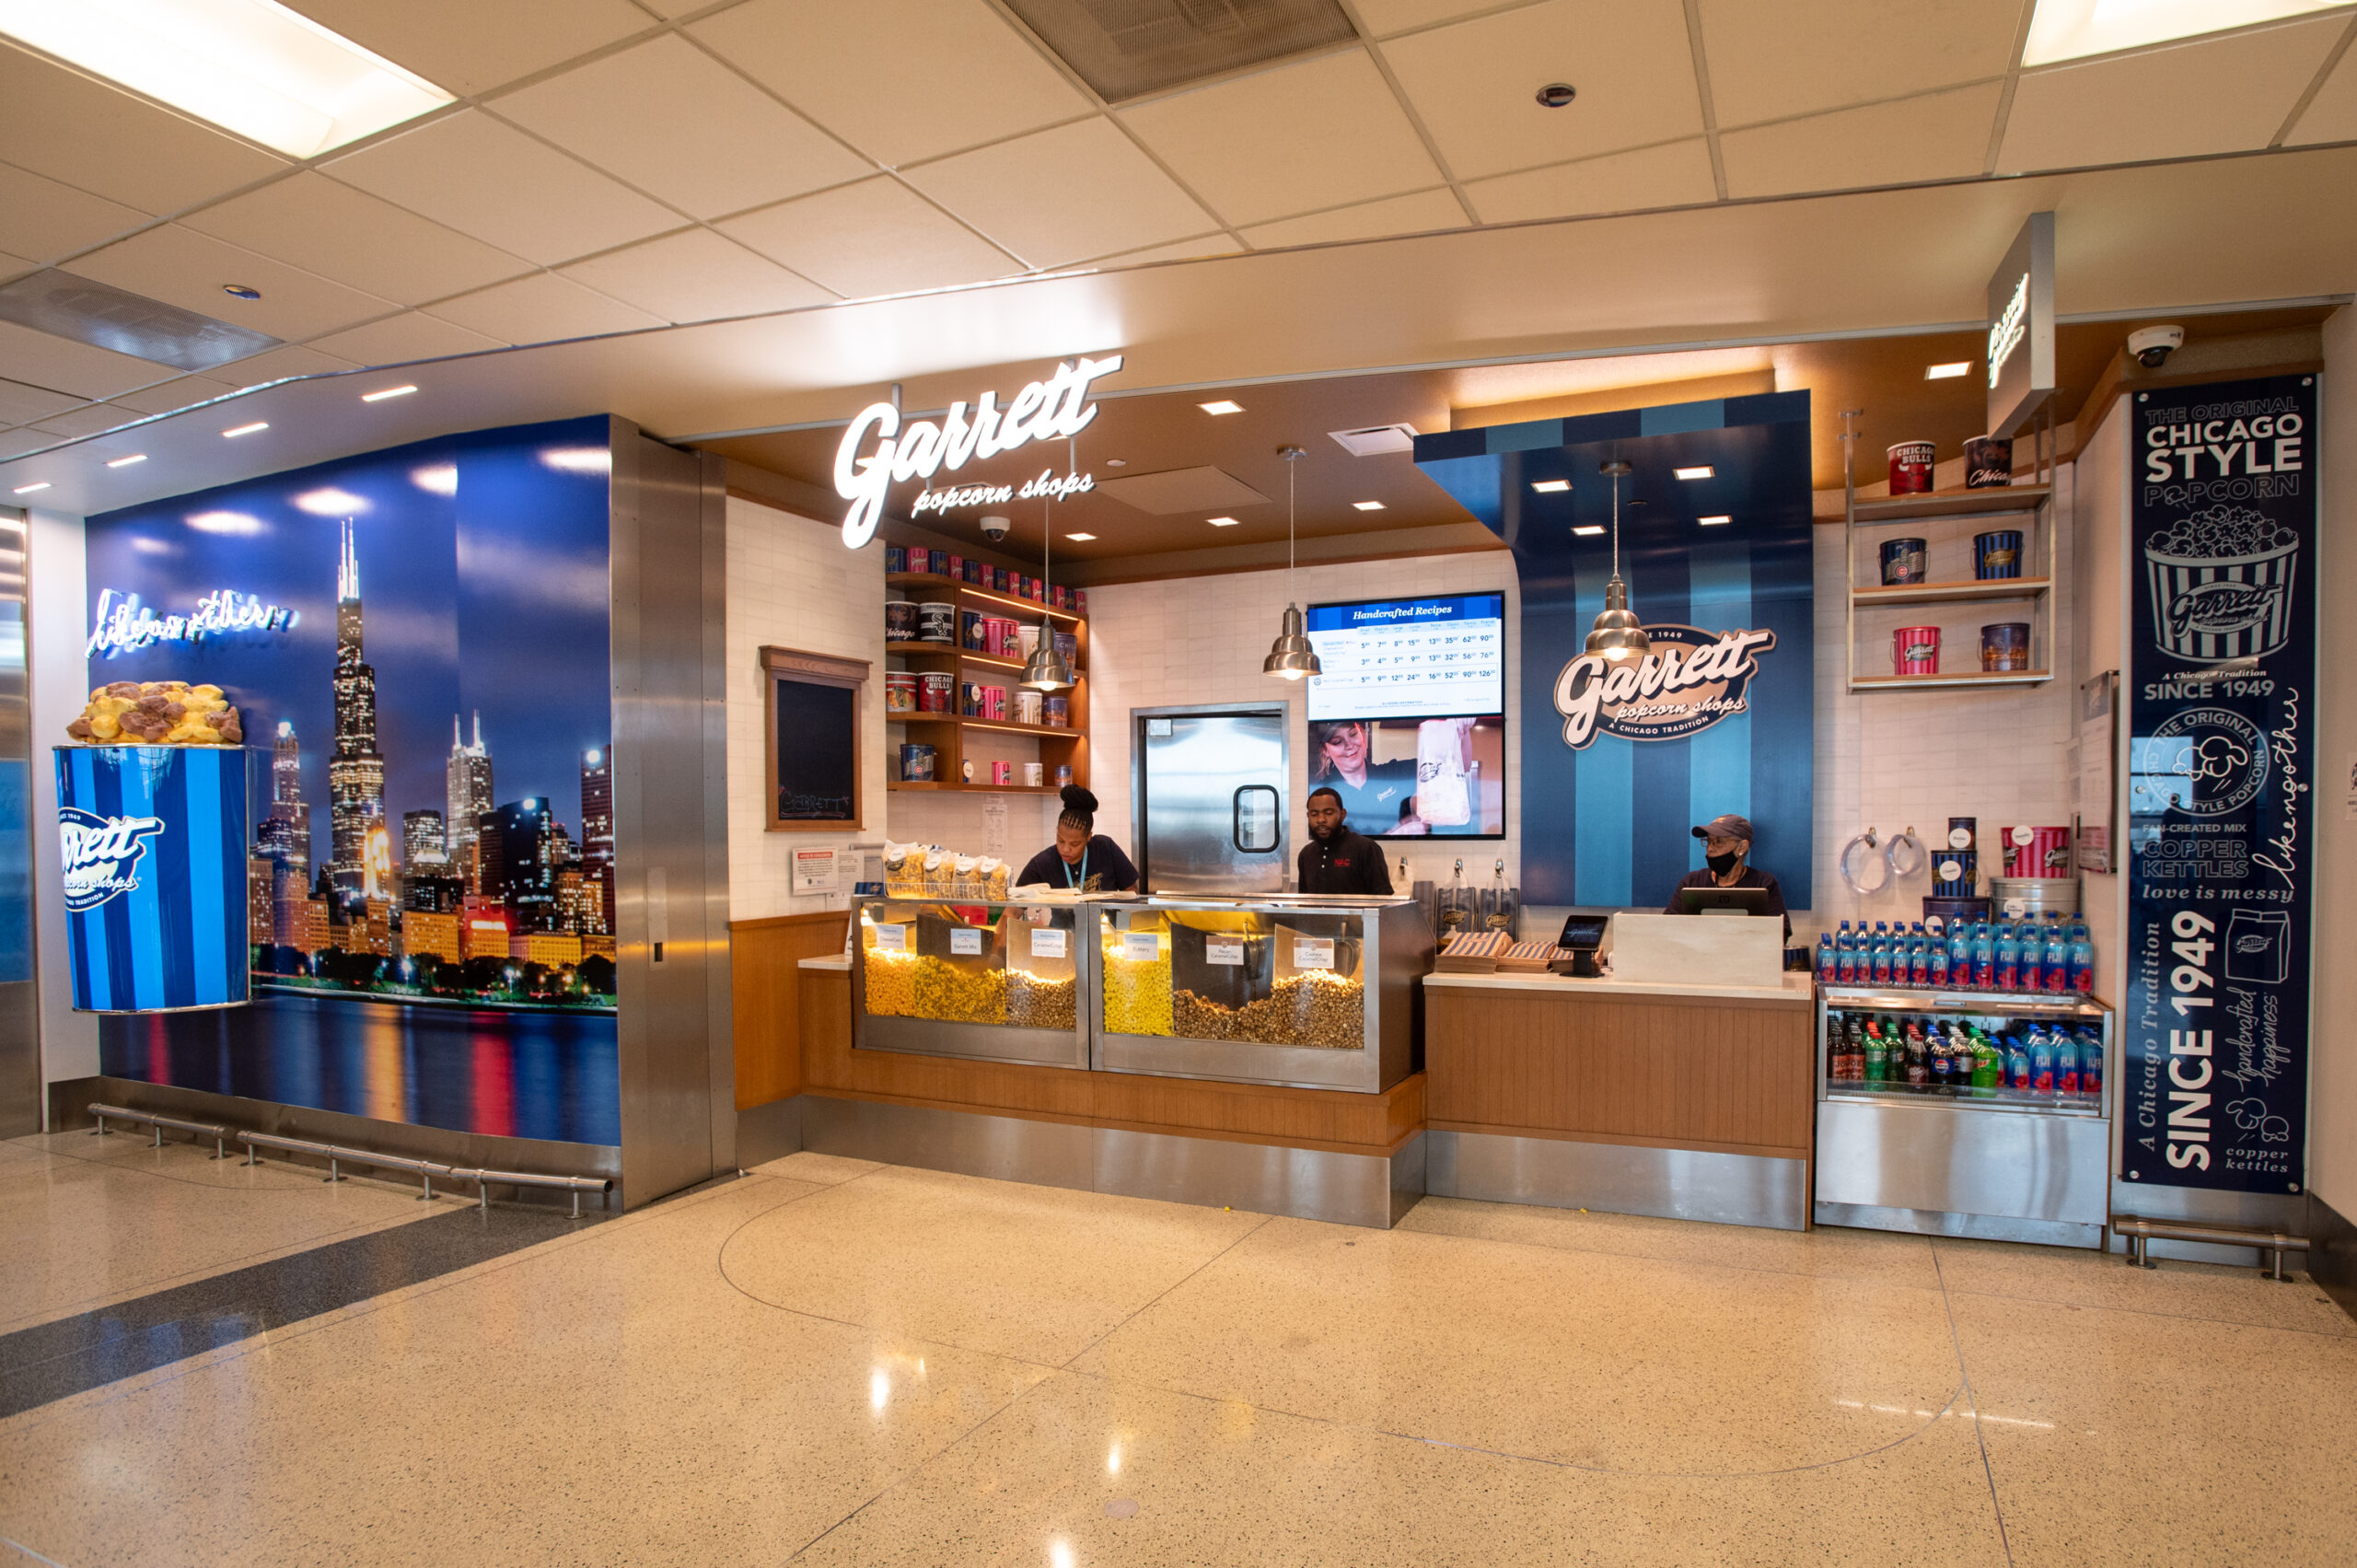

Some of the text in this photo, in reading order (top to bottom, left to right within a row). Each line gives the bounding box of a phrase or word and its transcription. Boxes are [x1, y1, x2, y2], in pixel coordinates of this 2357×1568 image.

[2145, 396, 2299, 425] THE ORIGINAL
[2146, 413, 2303, 447] CHICAGO
[833, 354, 1124, 550] Garrett
[1902, 454, 1932, 464] BULLS
[2145, 436, 2303, 482] STYLE
[911, 469, 1097, 518] popcorn shops
[1353, 605, 1452, 620] Handcrafted Recipes
[2168, 584, 2282, 636] Garrett
[2174, 671, 2211, 680] Chicago
[2218, 669, 2268, 679] Tradition
[1557, 632, 1769, 746] Garrett
[2143, 679, 2275, 700] SINCE 1949
[1614, 695, 1746, 722] popcorn shops
[1620, 725, 1658, 735] CHICAGO
[1662, 716, 1709, 734] TRADITION
[2153, 712, 2259, 746] THE ORIGINAL
[2148, 749, 2266, 813] CHICAGO STYLE POPCORN
[2142, 823, 2247, 833] FAN-CREATED MIX
[2142, 839, 2247, 858] COPPER
[2142, 860, 2249, 878] KETTLES
[2142, 885, 2294, 903] love is messy
[1953, 948, 1967, 958] FIJI
[1977, 950, 1991, 961] FIJI
[2001, 951, 2014, 962] FIJI
[2024, 952, 2038, 963] FIJI
[2048, 952, 2062, 963] FIJI
[2074, 953, 2089, 964] FIJI
[2138, 922, 2162, 1152] A Chicago Tradition
[2165, 911, 2215, 1172] SINCE 1949
[2222, 986, 2258, 1092] handcrafted
[2256, 993, 2292, 1087] happiness
[2036, 1056, 2051, 1067] FIJI
[2061, 1056, 2075, 1067] FIJI
[2225, 1147, 2288, 1160] copper
[2225, 1159, 2289, 1173] kettles
